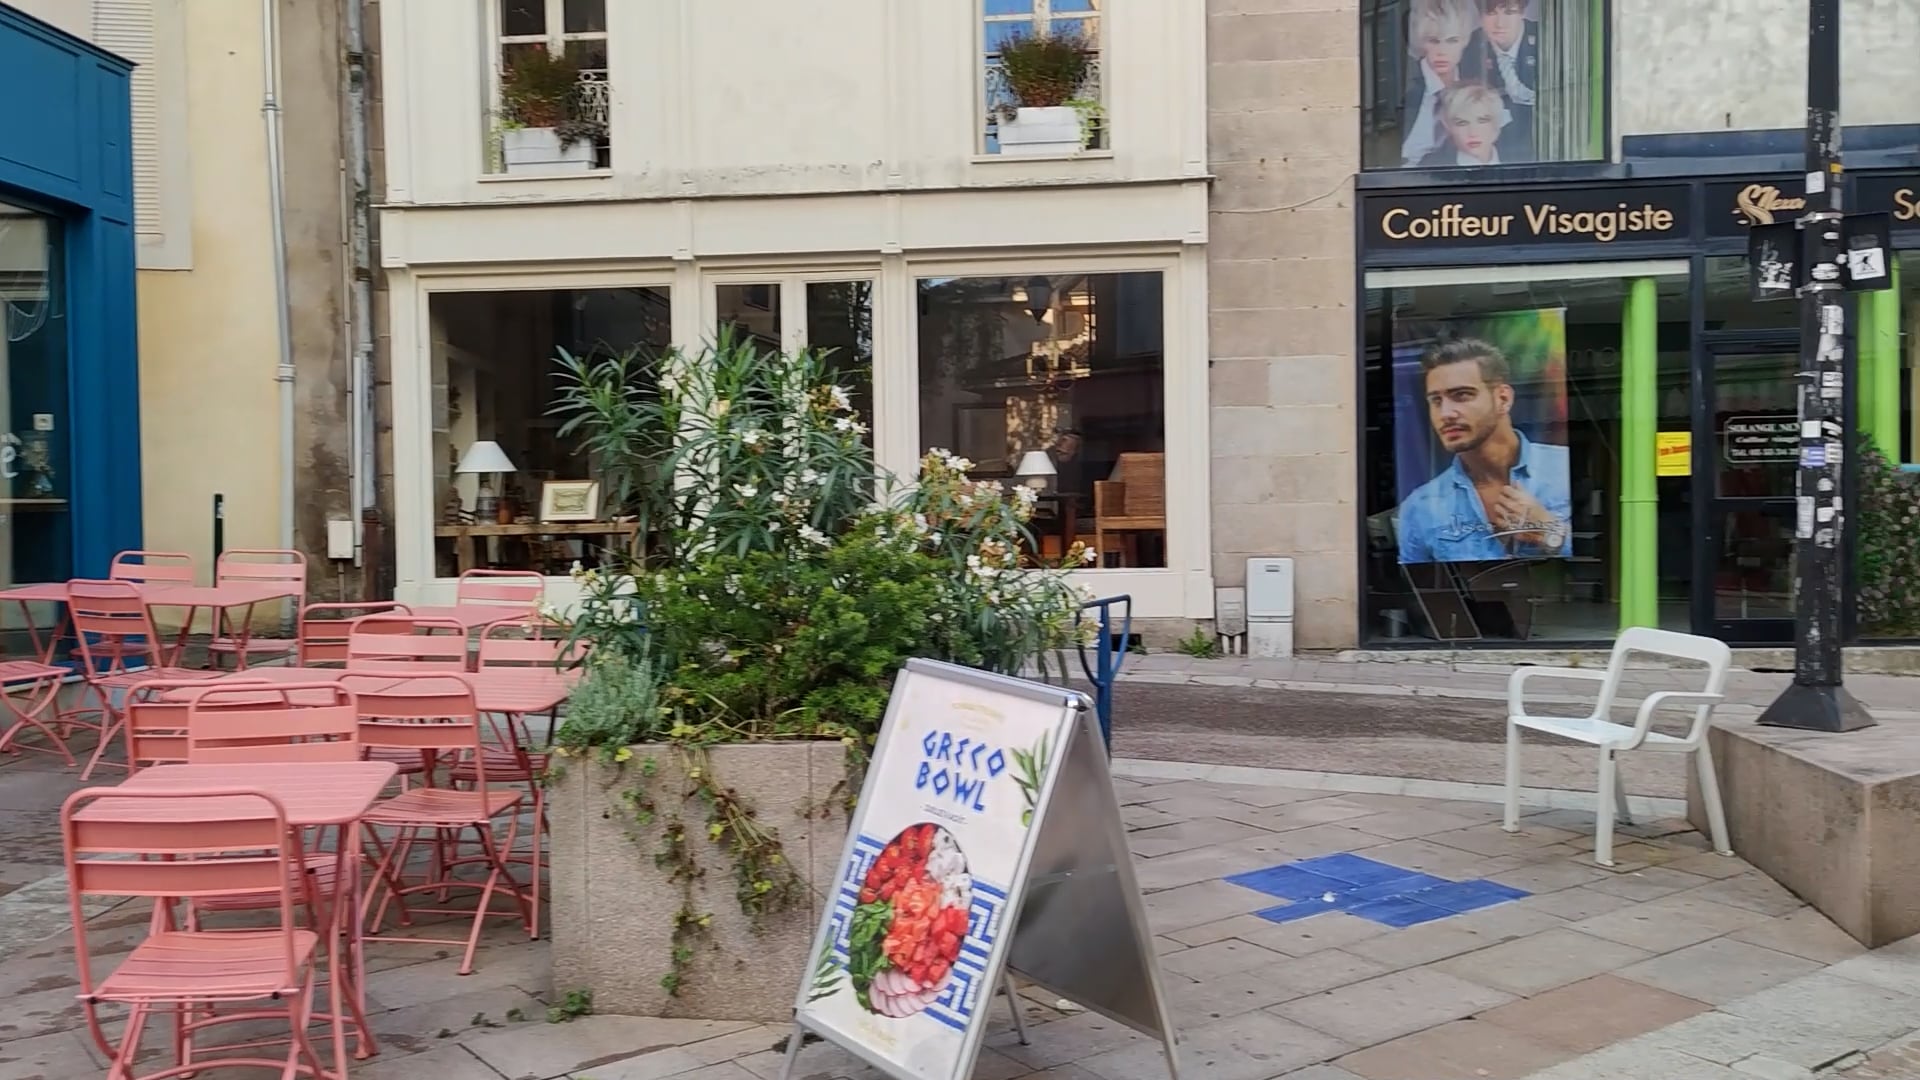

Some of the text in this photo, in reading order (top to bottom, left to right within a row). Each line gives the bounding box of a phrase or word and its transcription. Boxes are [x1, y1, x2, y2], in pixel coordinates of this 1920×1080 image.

[1381, 203, 1674, 241] Coiffeur Visagiste
[1893, 188, 1920, 220] S
[916, 761, 985, 811] BOWL
